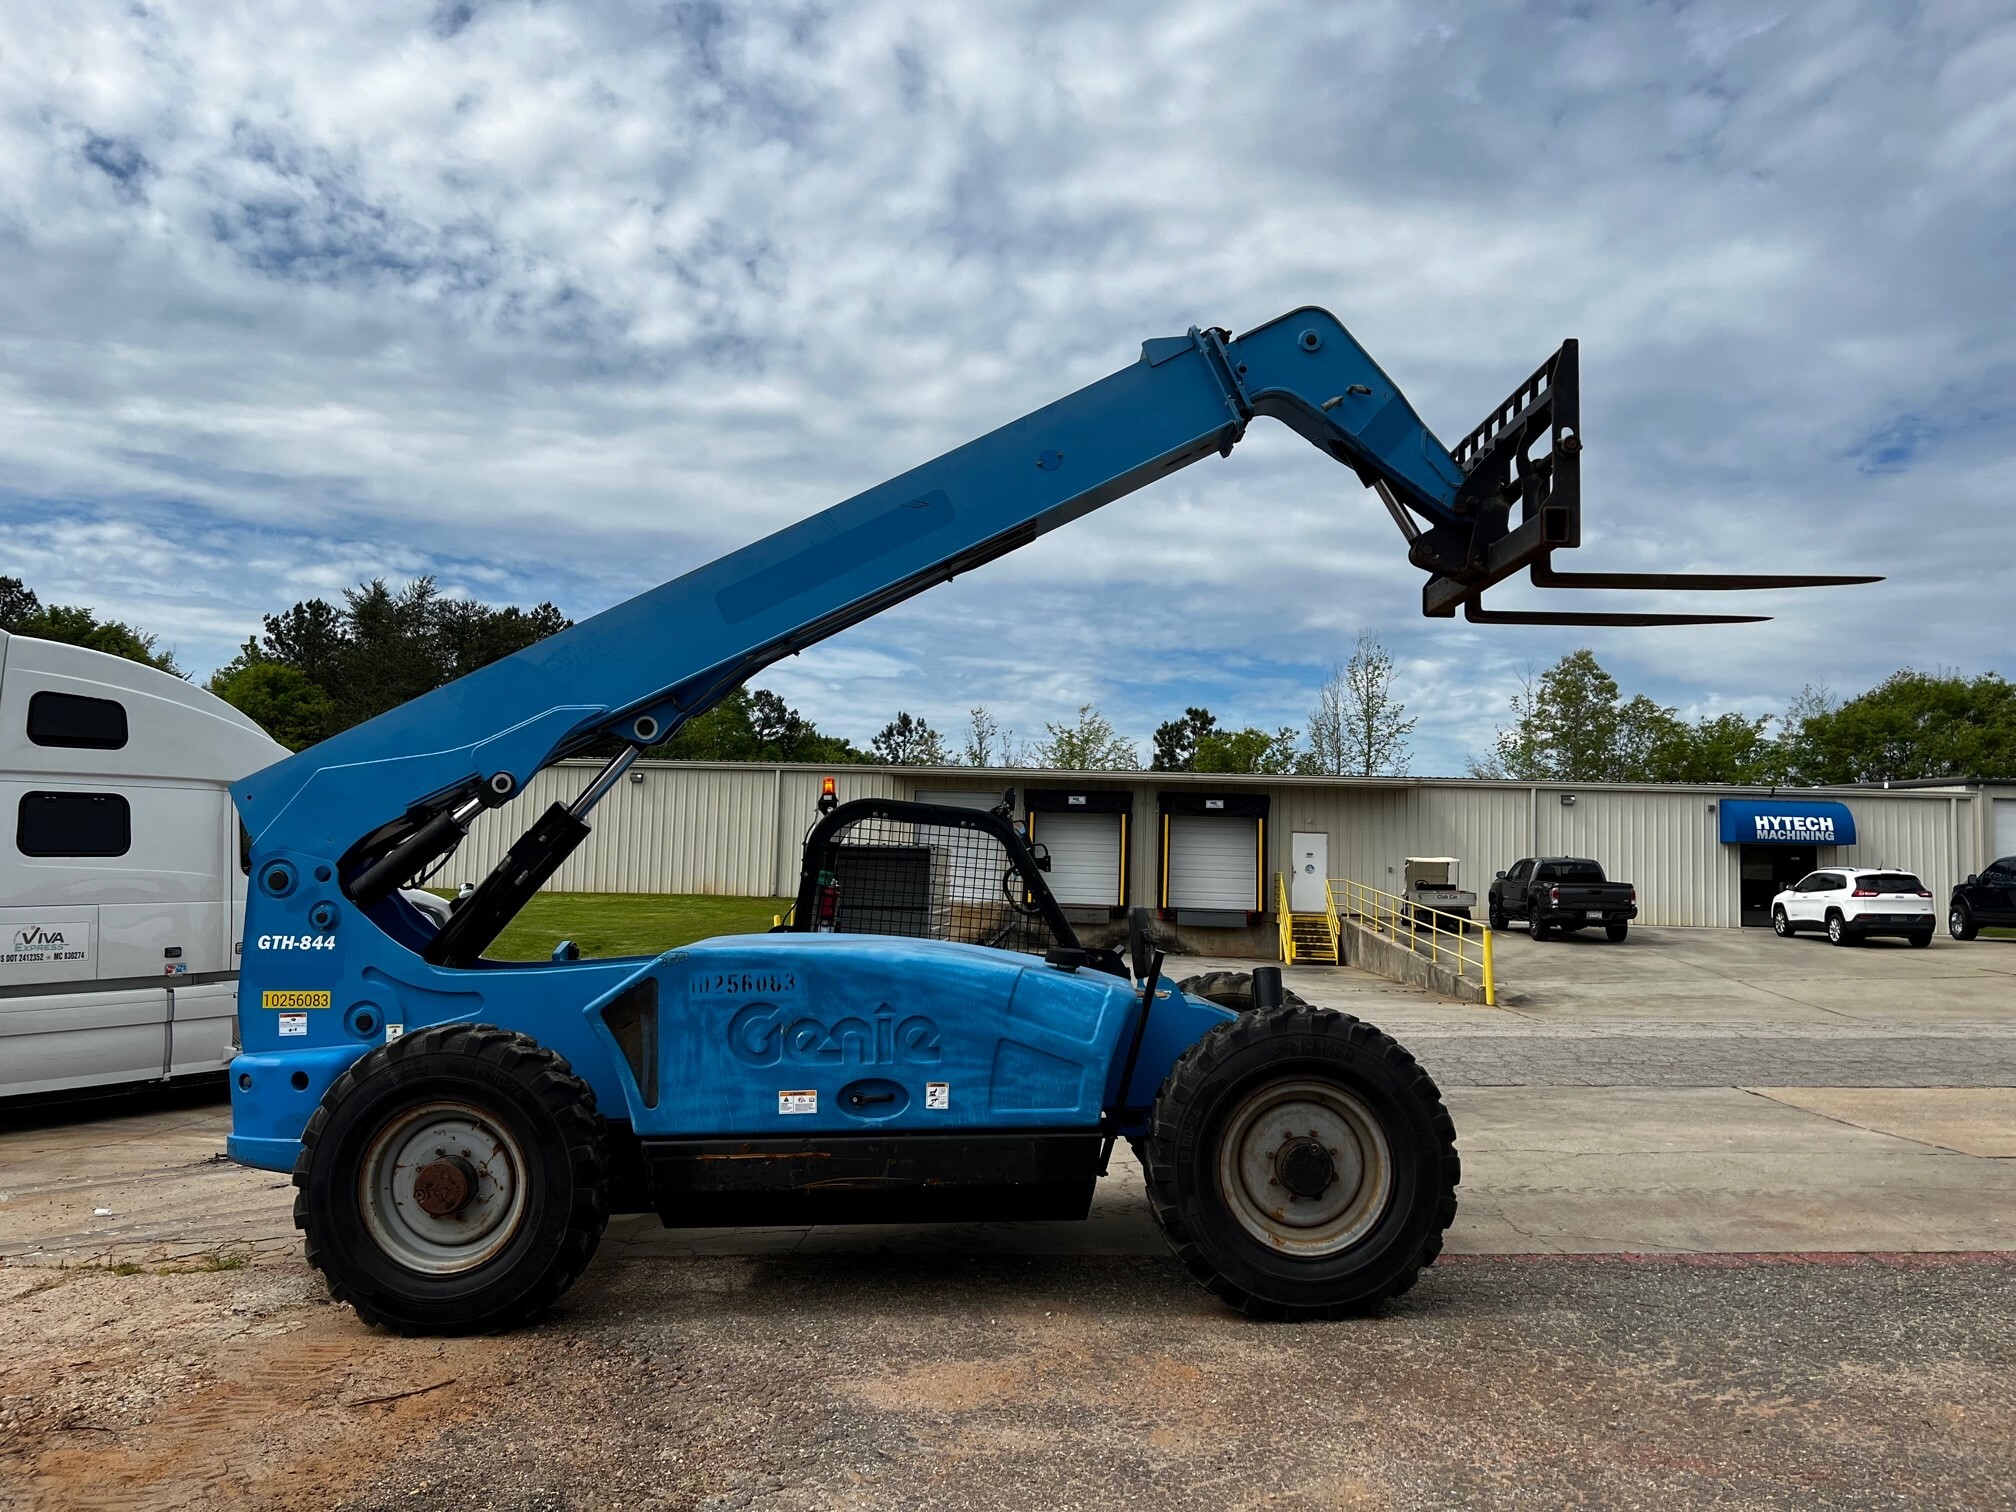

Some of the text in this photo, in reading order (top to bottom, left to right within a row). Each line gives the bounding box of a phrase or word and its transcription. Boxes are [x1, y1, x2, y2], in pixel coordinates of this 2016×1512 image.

[1754, 815, 1834, 831] HYTECH
[1757, 829, 1835, 841] MACHINING
[258, 935, 336, 950] GTH-844
[6, 954, 17, 963] DOT
[19, 953, 44, 962] 2412352
[54, 952, 63, 960] MC
[64, 951, 85, 960] 830274
[691, 972, 796, 994] 10256083
[264, 993, 329, 1007] 10256083
[727, 1001, 942, 1069] Genie
